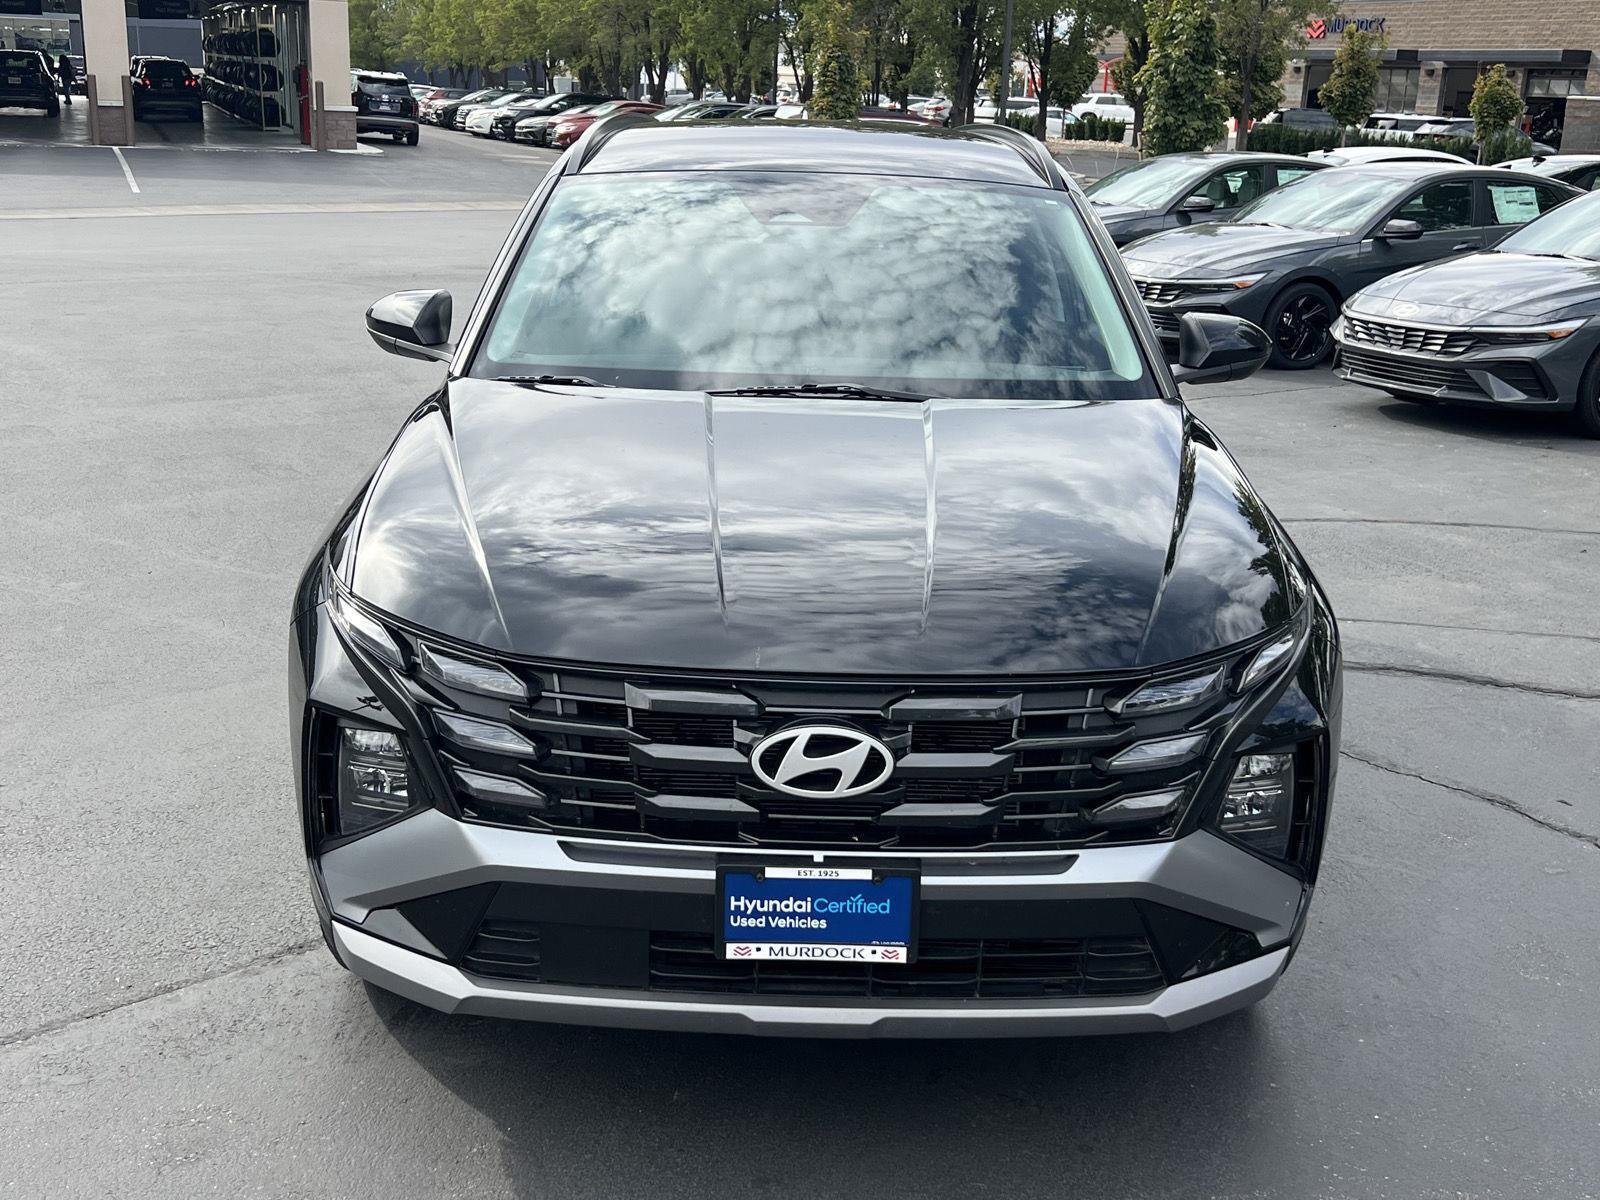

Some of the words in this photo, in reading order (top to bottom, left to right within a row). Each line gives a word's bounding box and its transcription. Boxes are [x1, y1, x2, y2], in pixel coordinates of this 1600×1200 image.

[797, 869, 816, 877] EST.
[818, 869, 840, 877] 1925
[730, 895, 812, 915] Hyundai
[813, 894, 891, 914] Certified
[730, 915, 766, 927] Used
[768, 916, 828, 929] Vehicles
[768, 946, 866, 960] MURDOCK
